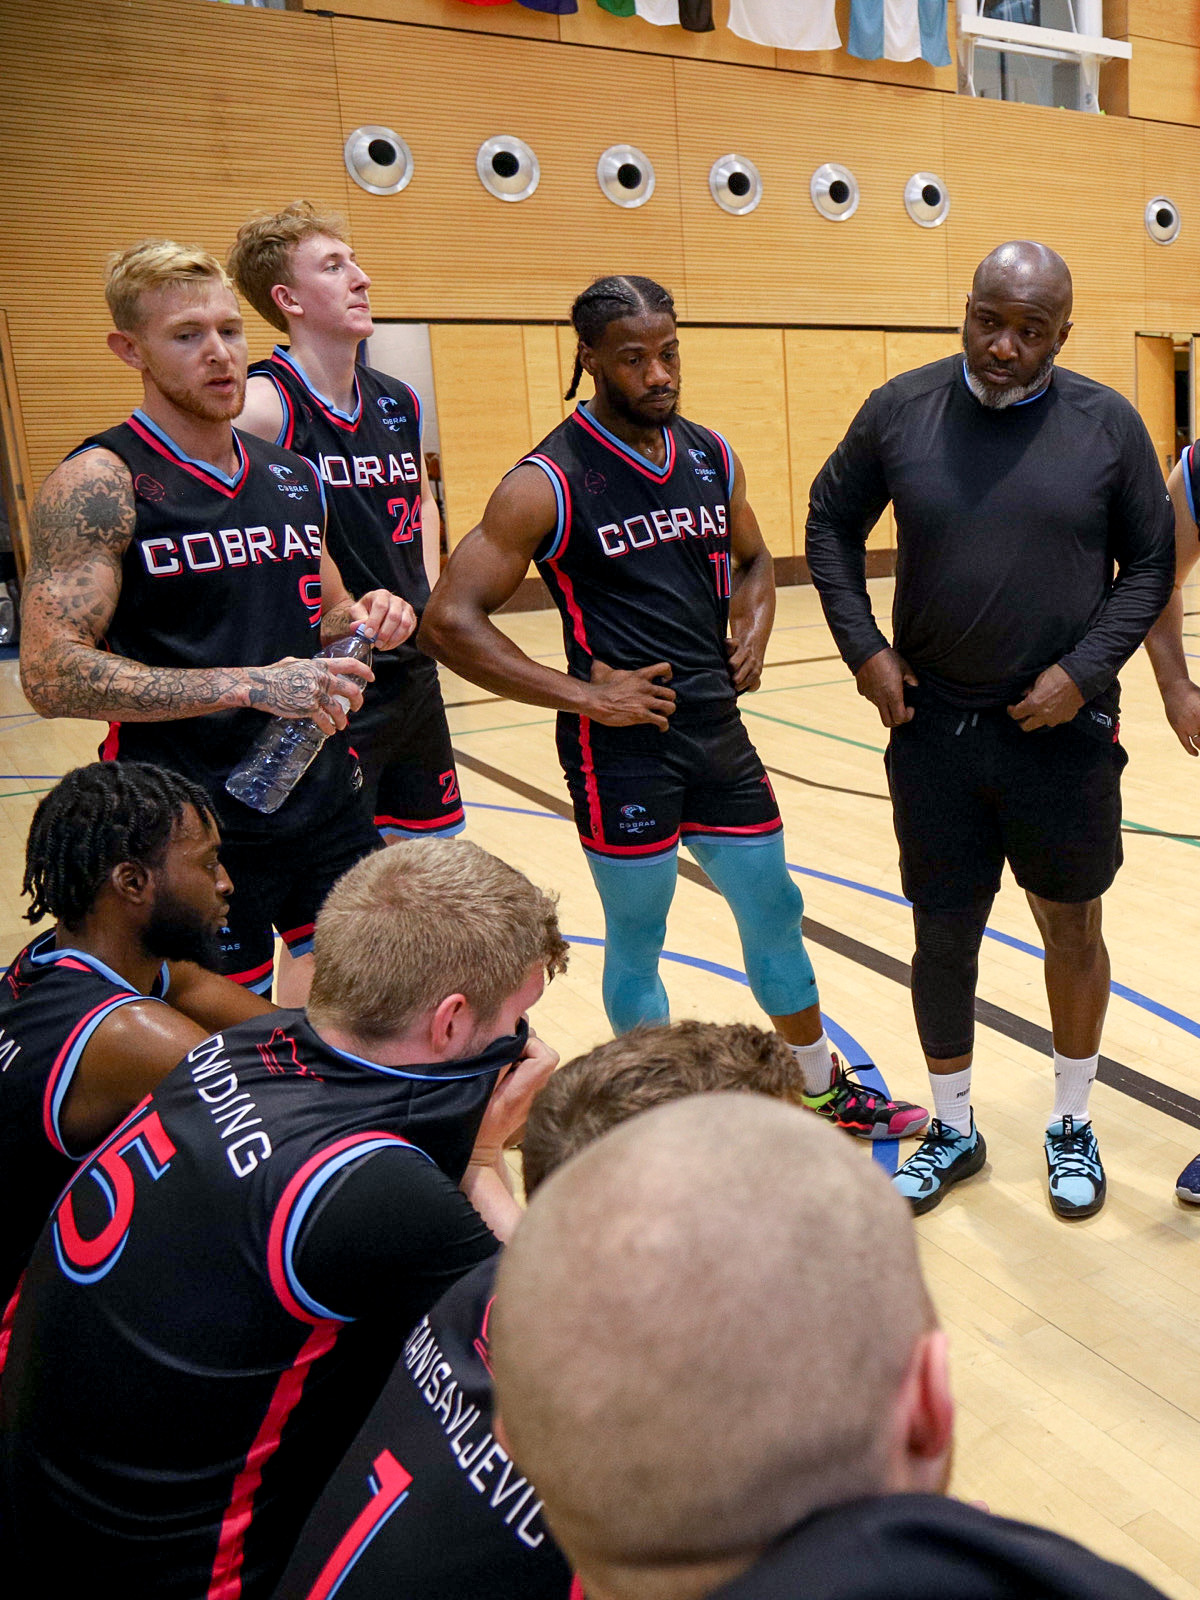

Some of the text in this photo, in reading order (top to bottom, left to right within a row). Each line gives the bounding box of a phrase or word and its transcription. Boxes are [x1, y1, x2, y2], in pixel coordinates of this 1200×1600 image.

[140, 523, 323, 578] COBRAS
[597, 504, 728, 559] COBRAS
[618, 819, 656, 830] COBRAS
